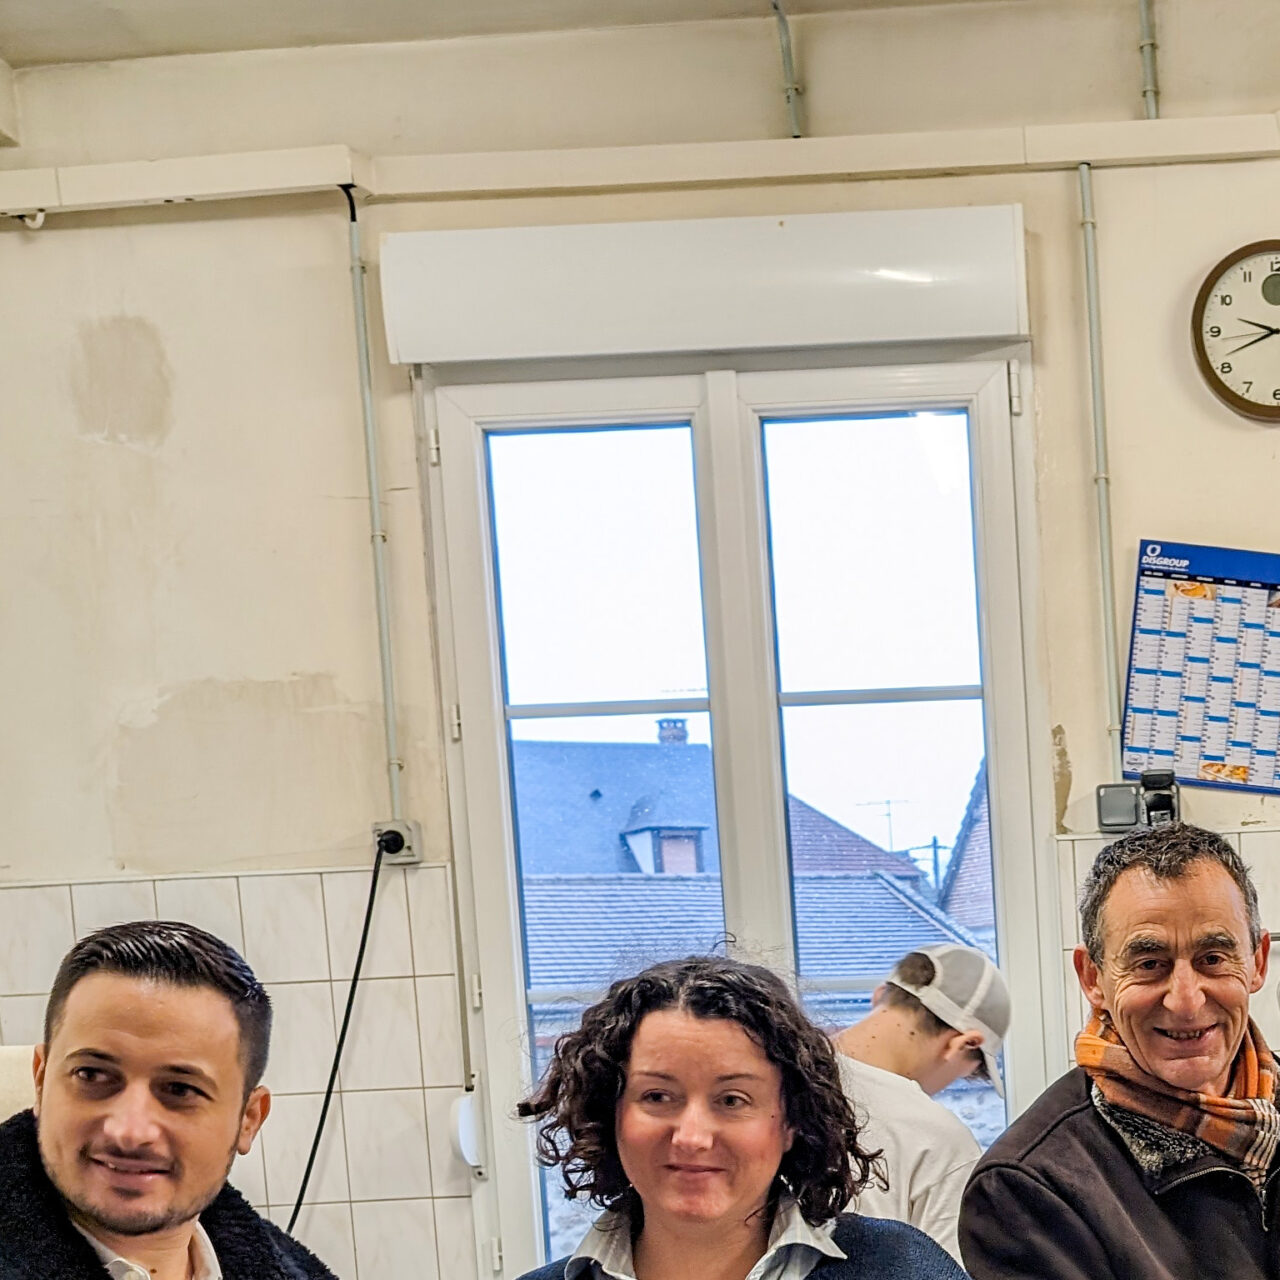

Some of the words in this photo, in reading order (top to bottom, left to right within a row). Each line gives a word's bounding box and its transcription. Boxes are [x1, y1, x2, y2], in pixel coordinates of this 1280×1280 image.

[1243, 271, 1252, 283] 11
[1220, 294, 1232, 306] 10
[1209, 326, 1222, 338] 9
[1220, 362, 1232, 374] 8
[1242, 381, 1253, 394] 7
[1142, 556, 1190, 567] DISGROUP
